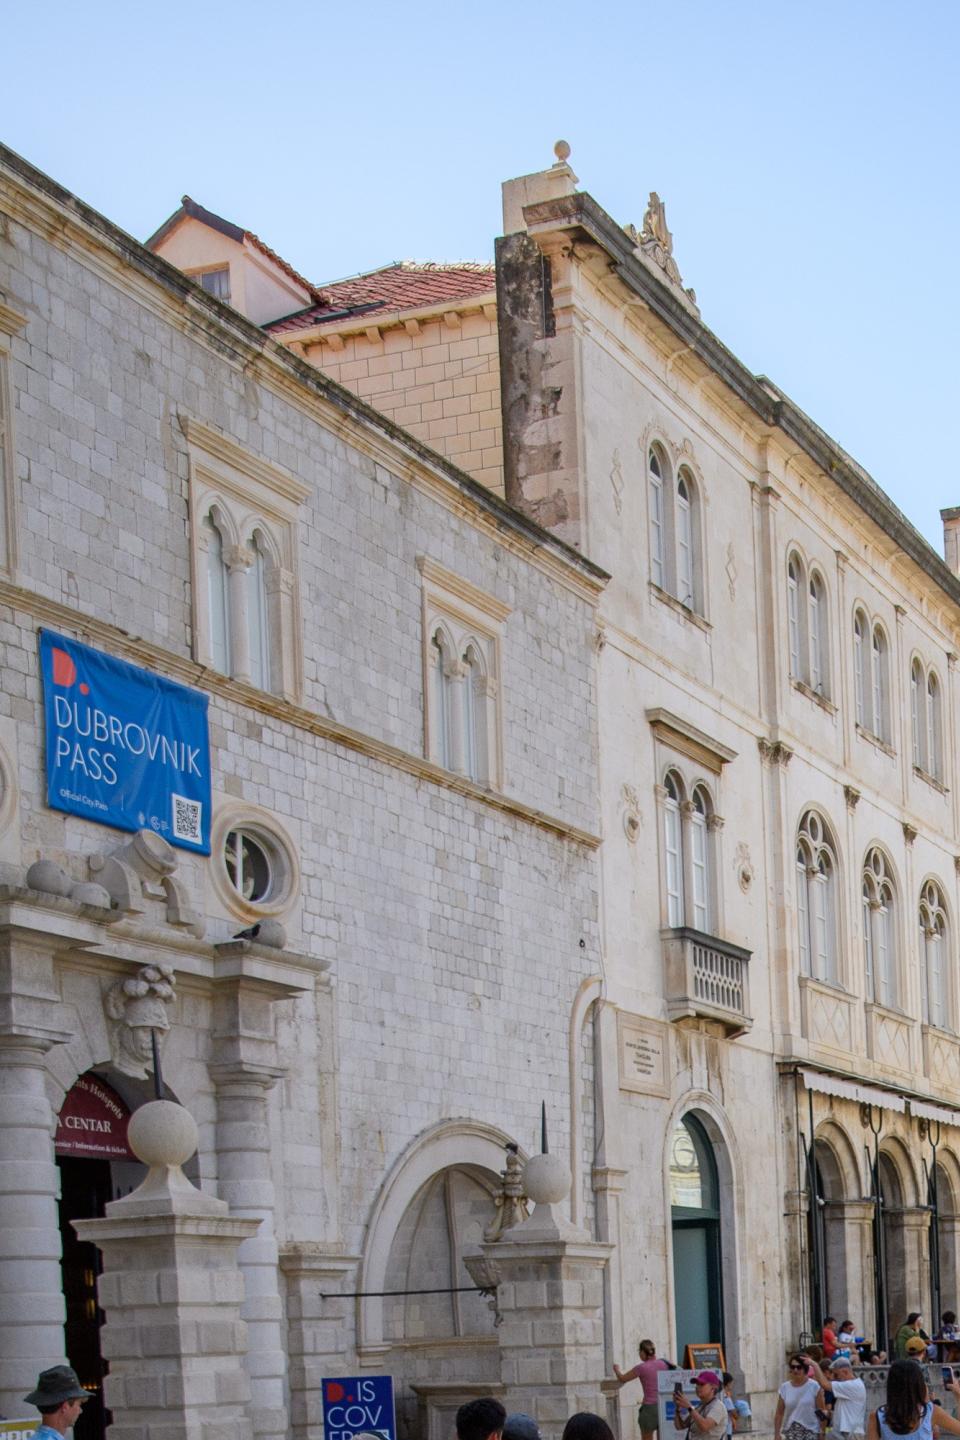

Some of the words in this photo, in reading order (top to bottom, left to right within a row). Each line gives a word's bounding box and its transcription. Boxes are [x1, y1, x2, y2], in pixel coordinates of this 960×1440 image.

[54, 695, 203, 778] DUBROVNIK
[57, 736, 118, 786] PASS
[59, 788, 82, 802] Official
[82, 795, 94, 809] City
[94, 799, 109, 812] Pass
[89, 1083, 124, 1120] Hotspots
[65, 1116, 112, 1134] CENTAR
[75, 1141, 106, 1151] Information
[327, 1405, 383, 1428] COV
